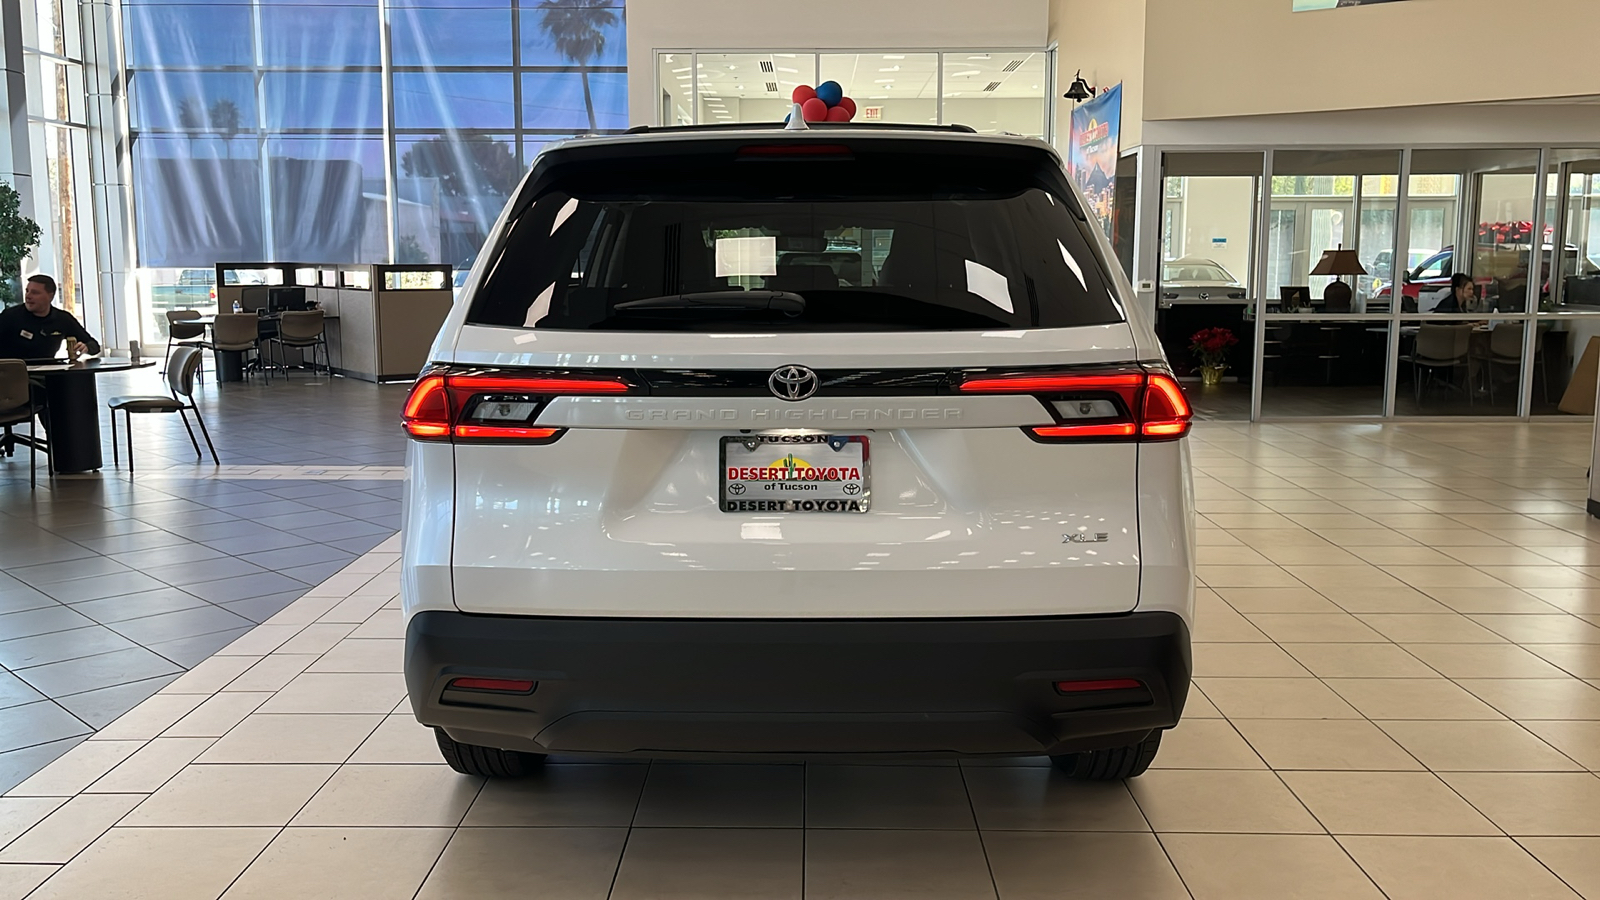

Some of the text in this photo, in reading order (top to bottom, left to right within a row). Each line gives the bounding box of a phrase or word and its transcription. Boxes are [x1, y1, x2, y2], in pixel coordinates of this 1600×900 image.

[624, 408, 964, 421] GRAND HIGHLANDER
[757, 434, 829, 443] TUCSON
[728, 467, 861, 480] DESERT TOYOTA
[764, 482, 818, 491] of Tucson
[727, 500, 861, 511] DESERT TOYOTA
[1061, 532, 1109, 544] XLE
